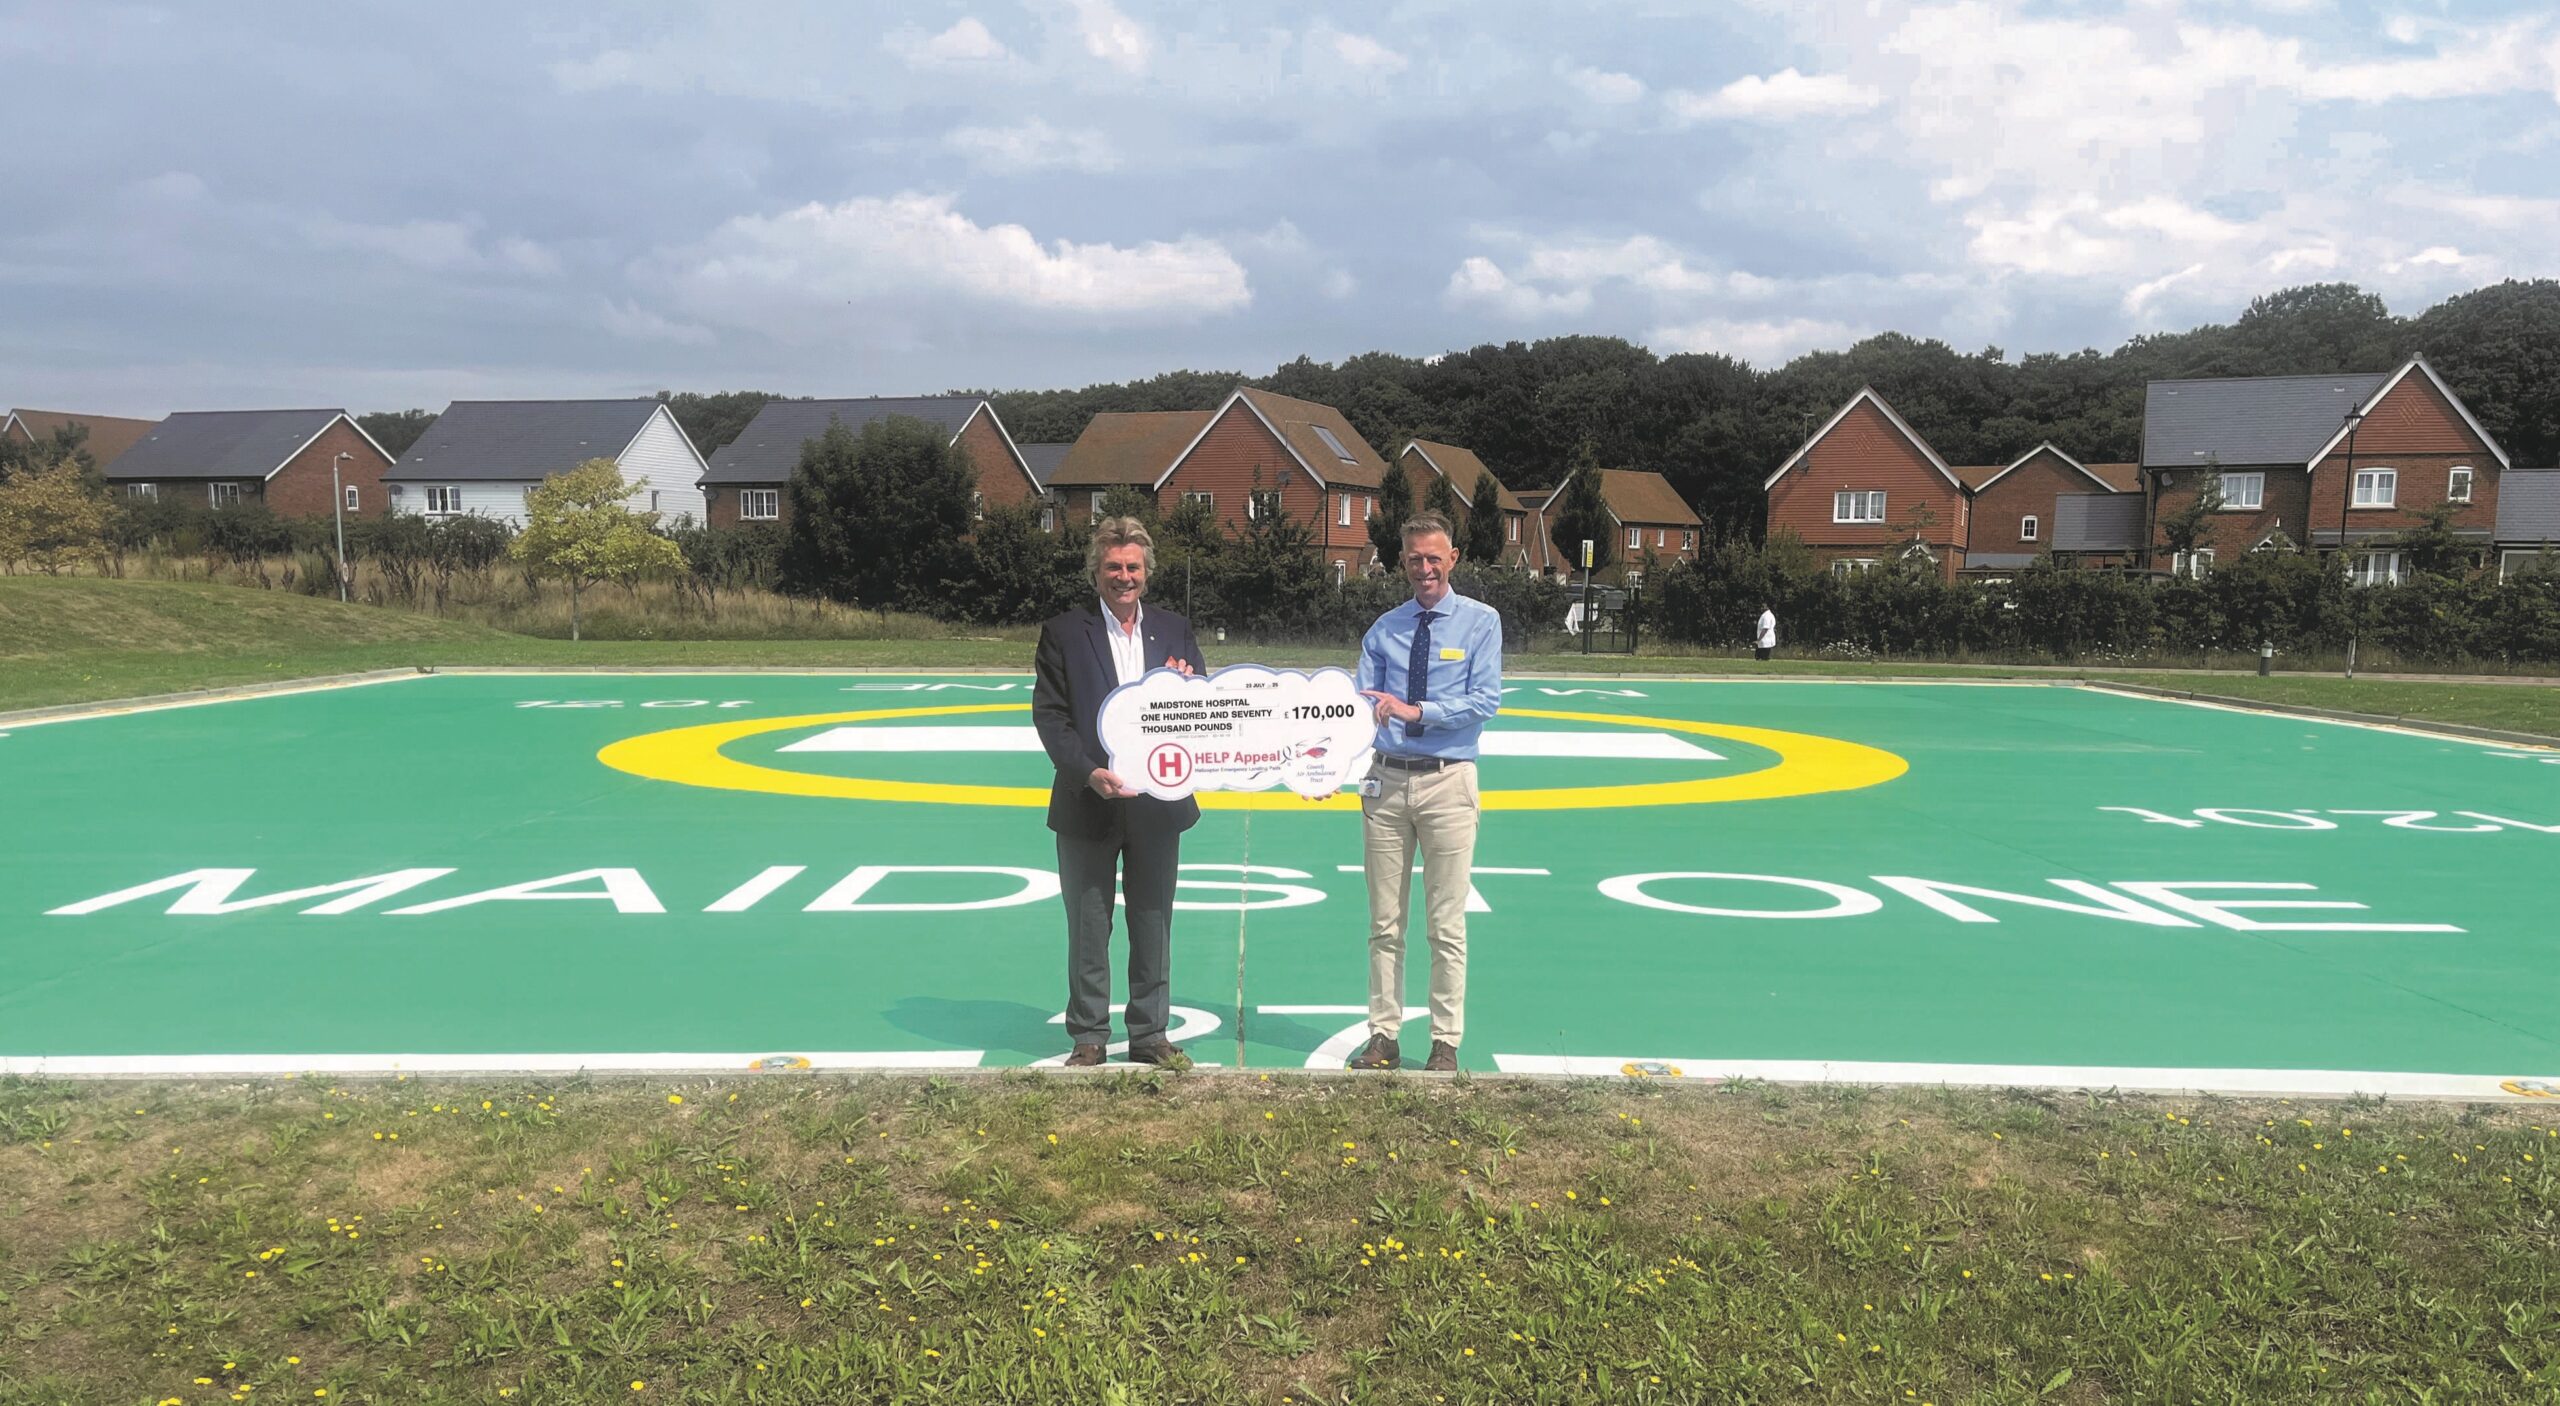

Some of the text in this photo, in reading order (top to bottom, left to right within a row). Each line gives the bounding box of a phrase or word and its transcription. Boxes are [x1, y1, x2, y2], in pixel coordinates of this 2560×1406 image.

[1150, 701, 1203, 709] MAIDSTONE
[1206, 699, 1250, 707] HOSPITAL
[1141, 710, 1273, 722] ONE HUNDRED AND SEVENTY
[1292, 704, 1355, 721] 170,000
[1141, 725, 1192, 733] THOUSAND
[1194, 723, 1233, 732] POUNDS
[1195, 750, 1281, 764] HELP Appeal
